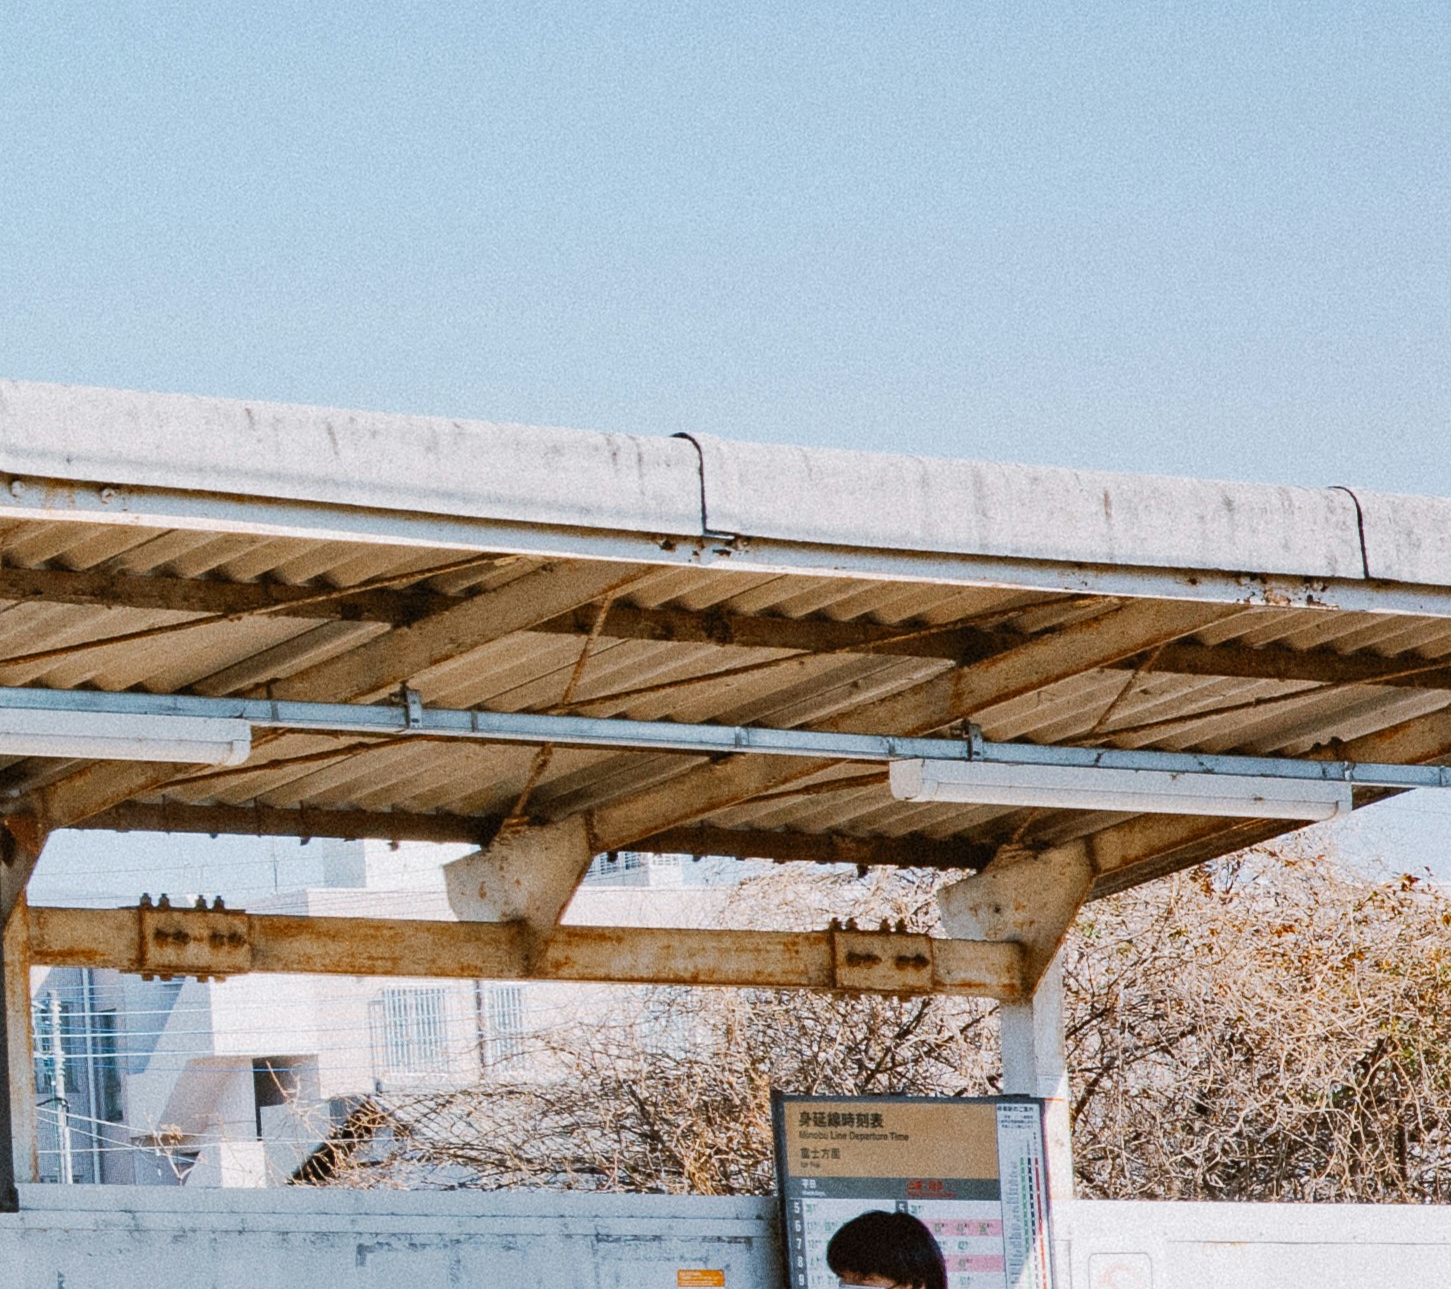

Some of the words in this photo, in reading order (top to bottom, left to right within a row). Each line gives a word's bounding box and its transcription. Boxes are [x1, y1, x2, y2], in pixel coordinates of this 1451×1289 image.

[794, 1202, 800, 1214] 5
[795, 1220, 801, 1232] 6
[796, 1238, 802, 1250] 7
[797, 1256, 804, 1268] 8
[798, 1274, 805, 1286] 9
